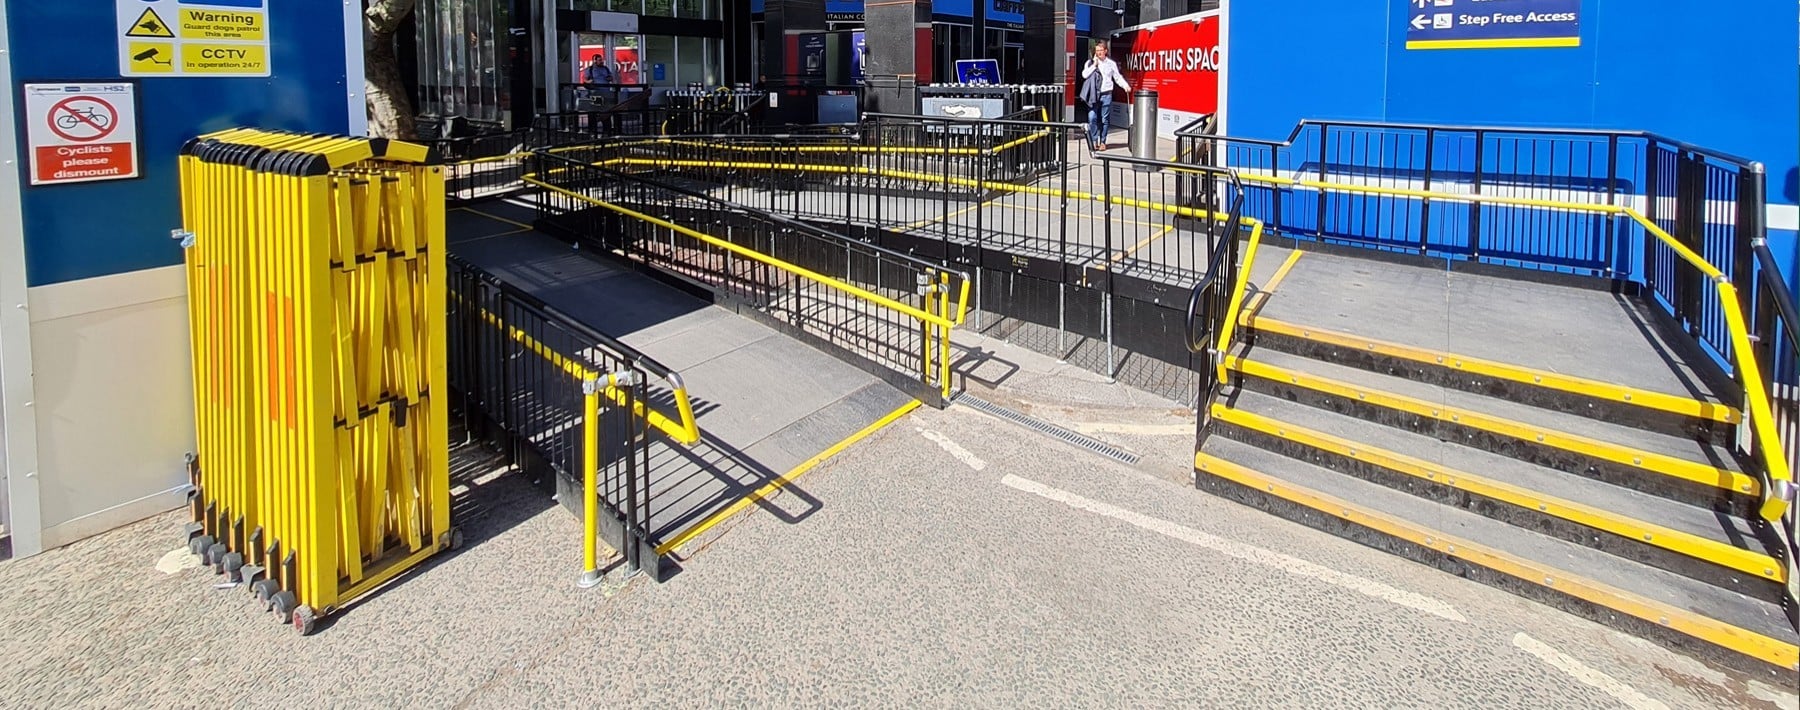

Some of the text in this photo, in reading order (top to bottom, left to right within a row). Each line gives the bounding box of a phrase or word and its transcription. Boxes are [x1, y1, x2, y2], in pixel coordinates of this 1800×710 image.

[189, 11, 254, 25] Warning
[1459, 11, 1576, 26] Step Free Access
[213, 24, 235, 32] dogs
[201, 48, 246, 59] CCTV
[1125, 45, 1219, 71] WATCH THIS SPAC
[57, 145, 113, 156] Cyclists
[62, 157, 109, 168] please
[53, 167, 119, 179] dismount
